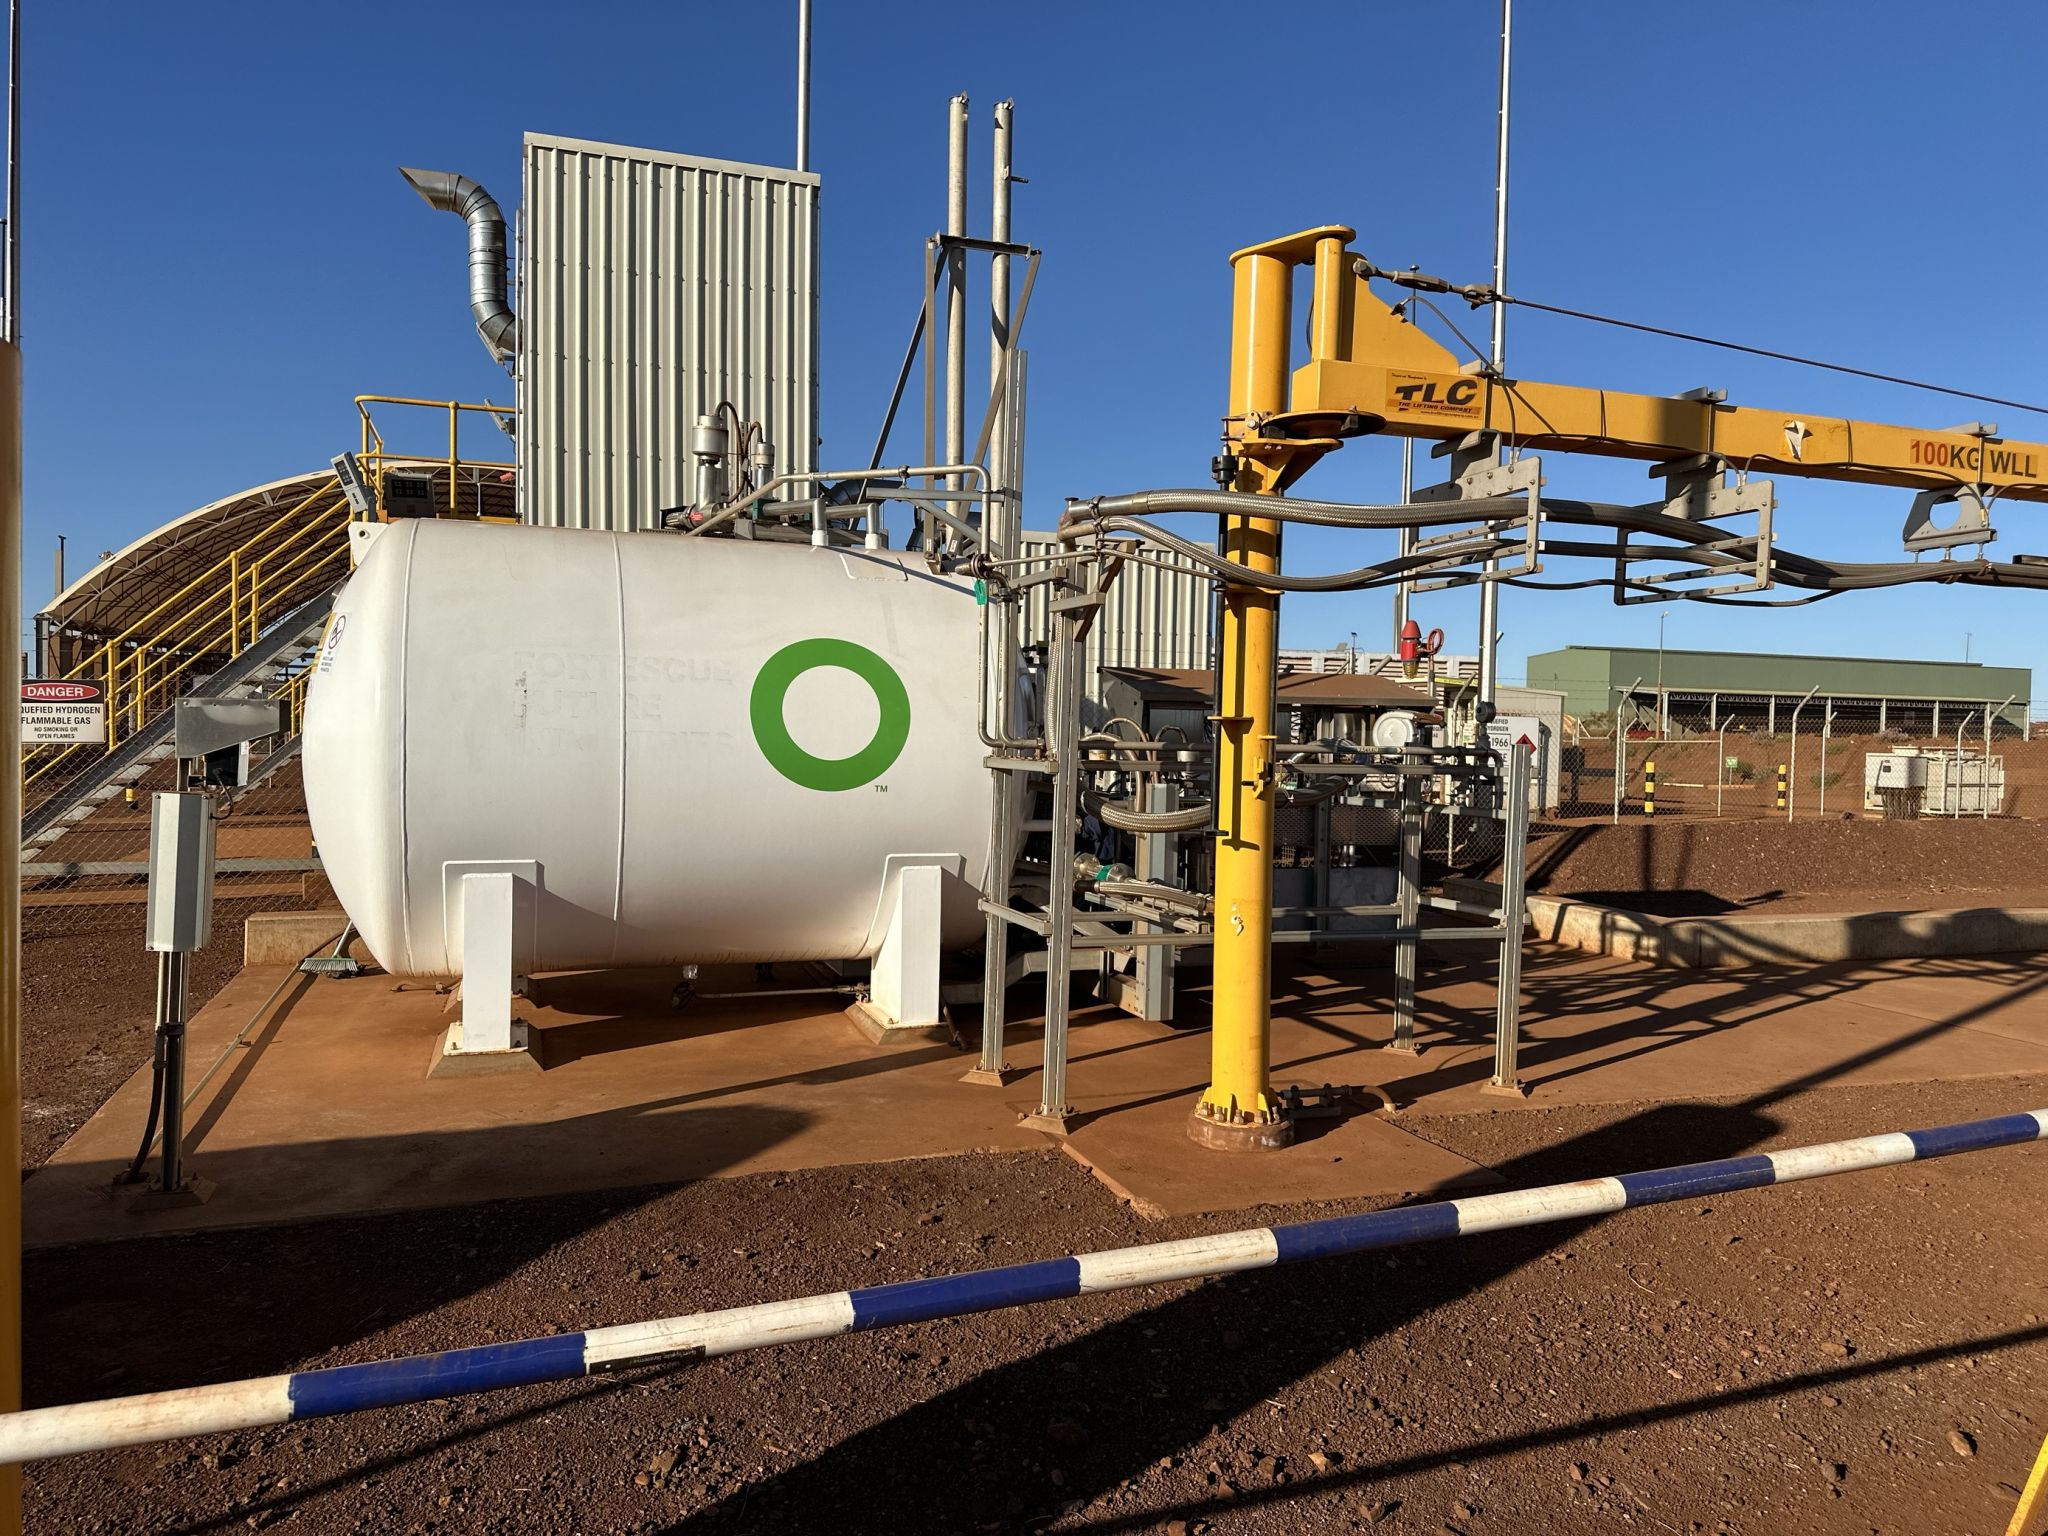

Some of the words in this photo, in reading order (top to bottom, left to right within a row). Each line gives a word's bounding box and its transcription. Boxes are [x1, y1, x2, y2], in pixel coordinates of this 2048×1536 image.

[1395, 379, 1478, 406] TLC
[1440, 405, 1473, 413] COMPANY
[1911, 440, 1979, 471] 100KG
[1989, 449, 2037, 478] WLL
[27, 687, 84, 697] DANGER
[20, 706, 53, 714] UEFIED
[55, 706, 101, 714] HYDROGEN
[21, 716, 72, 725] FLAMMABLE
[74, 717, 91, 725] GAS
[1491, 737, 1508, 747] 1966
[874, 785, 888, 793] TM
